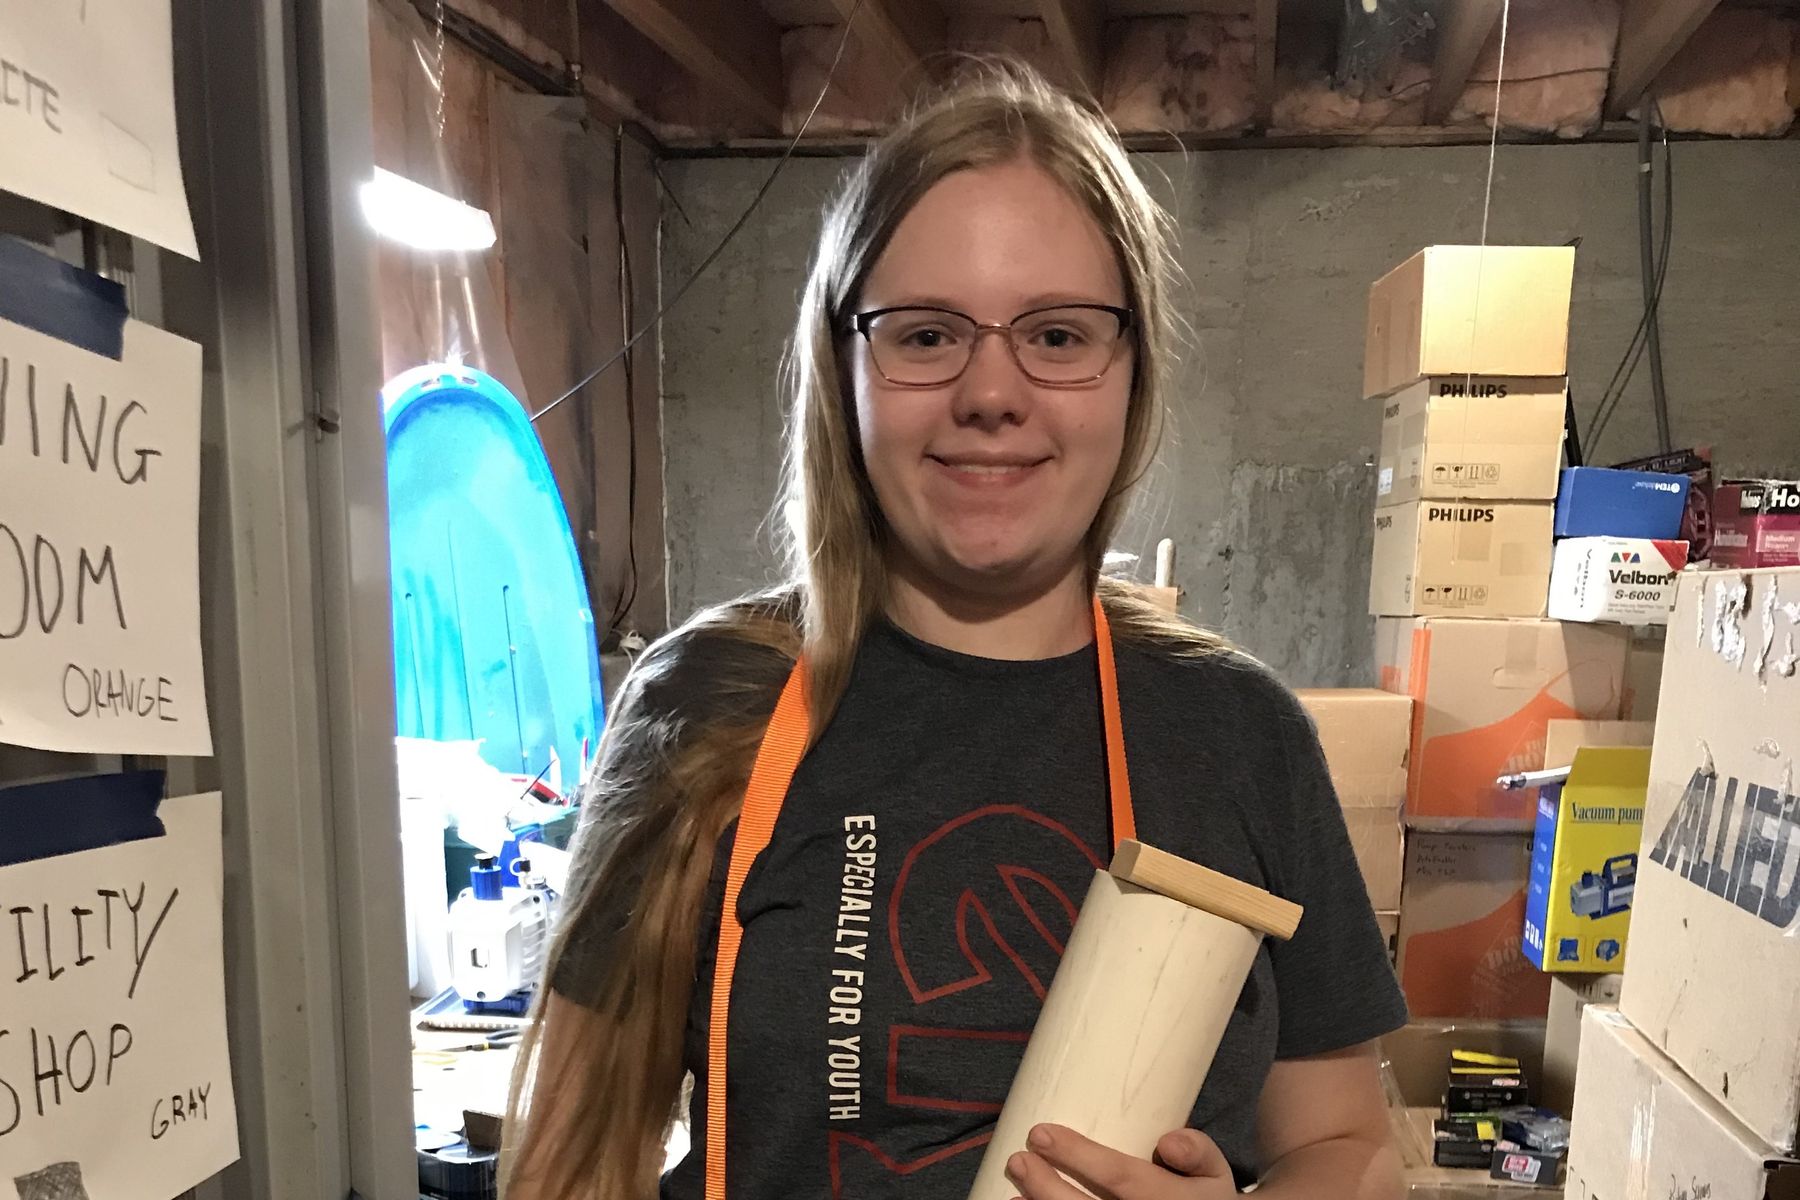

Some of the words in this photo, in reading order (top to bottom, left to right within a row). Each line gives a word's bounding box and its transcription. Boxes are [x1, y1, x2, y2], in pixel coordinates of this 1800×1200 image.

[1439, 384, 1508, 399] PHILIPS
[1428, 508, 1494, 523] PHILIPS
[1609, 569, 1669, 586] Velbon
[1614, 589, 1661, 602] S-6000
[62, 663, 178, 722] ORANGE
[1571, 802, 1615, 821] Vacuum
[832, 814, 876, 961] ESPECIALLY
[828, 969, 864, 1025] FOR
[827, 1035, 861, 1121] YOUTH
[151, 1082, 212, 1140] GRAY
